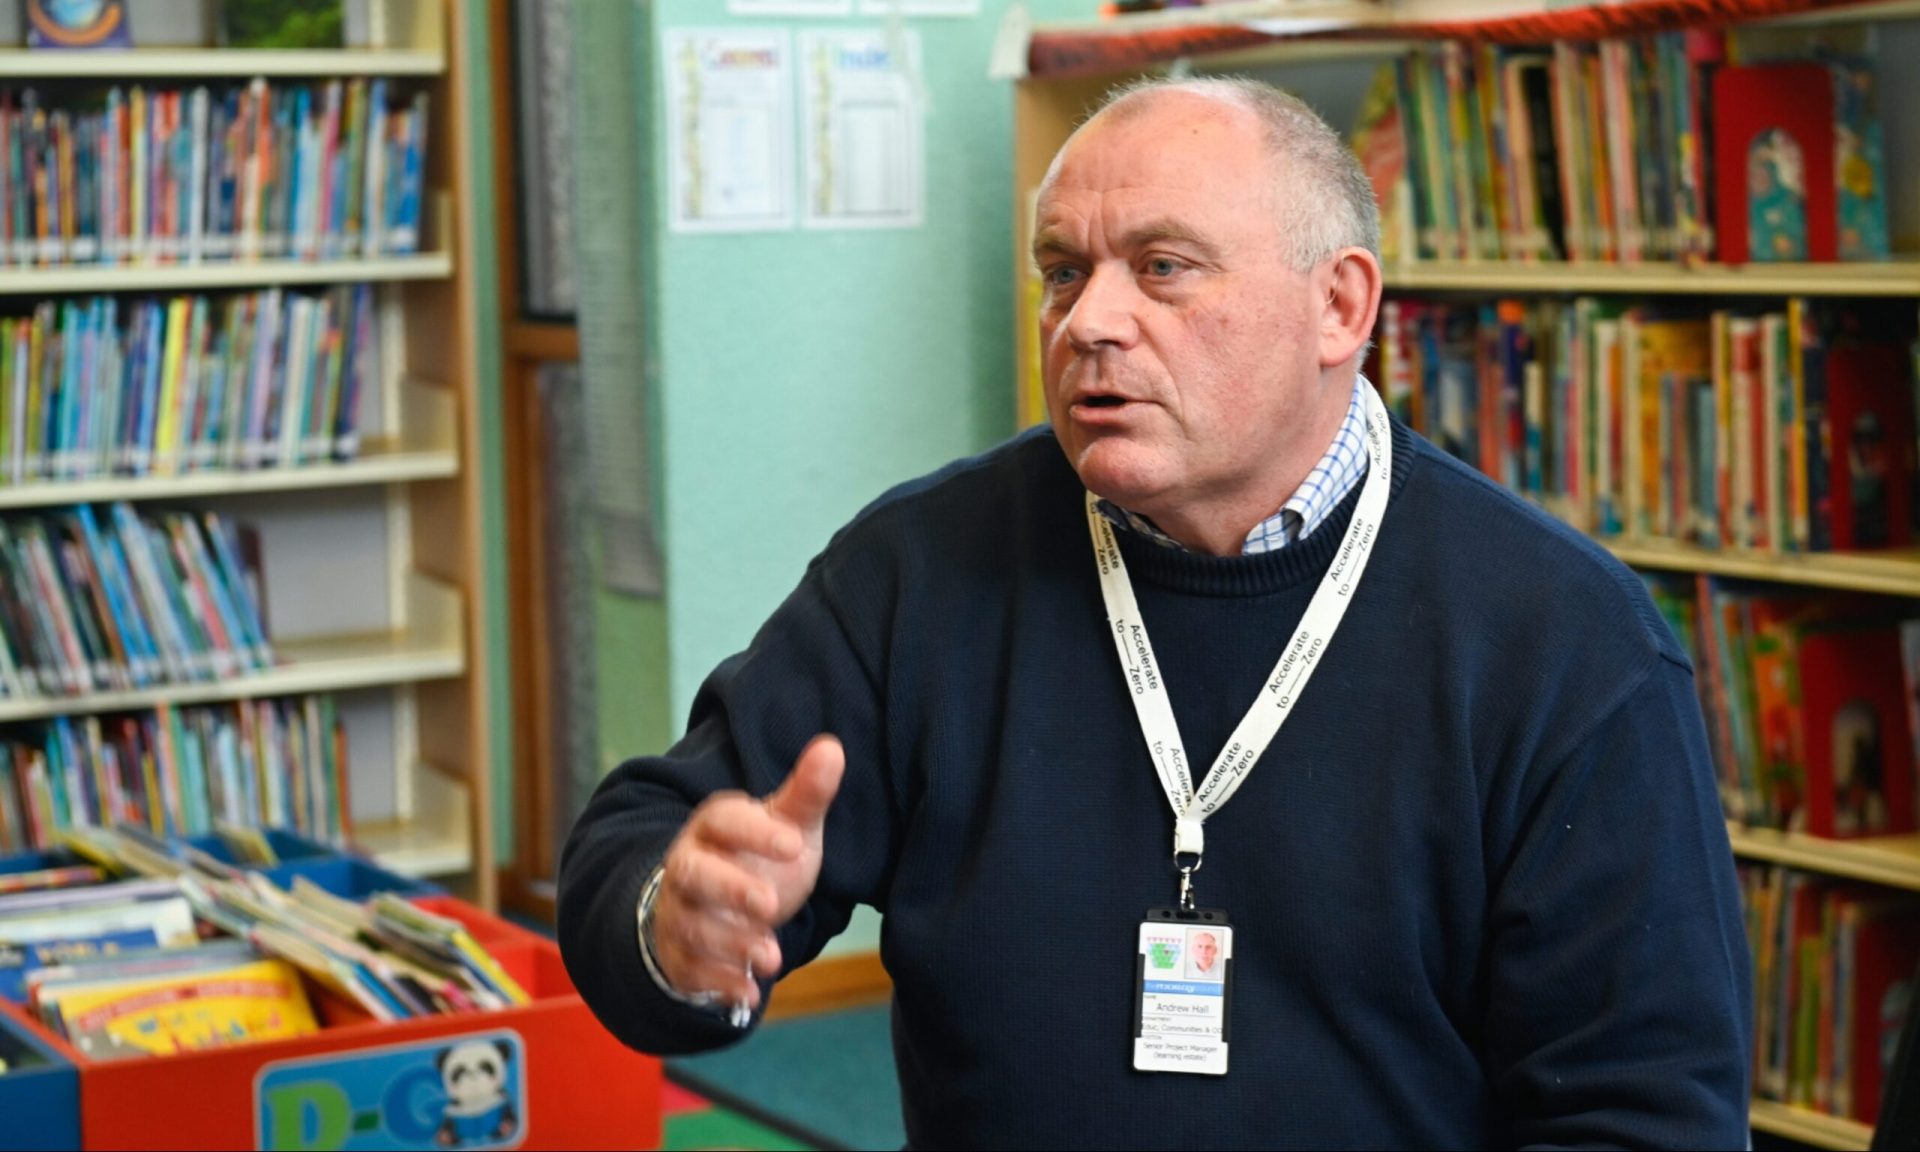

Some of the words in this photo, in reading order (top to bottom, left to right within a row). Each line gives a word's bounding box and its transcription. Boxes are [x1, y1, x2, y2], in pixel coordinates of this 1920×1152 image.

[1098, 546, 1109, 575] Zero
[1330, 518, 1363, 582] Accelerate
[1337, 583, 1350, 596] to
[1358, 523, 1375, 552] Zero
[1115, 619, 1125, 634] to
[1129, 665, 1144, 695] Zero
[1130, 624, 1158, 690] Accelerate
[1269, 631, 1310, 694] Accelerate
[1276, 696, 1290, 709] to
[1301, 638, 1323, 665] Zero
[1153, 740, 1164, 755] to
[1170, 747, 1192, 807] Accelera
[1199, 742, 1241, 803] Accelerate
[1202, 802, 1216, 813] to
[1231, 749, 1255, 777] Zero
[1156, 1003, 1189, 1012] Andrew
[1192, 1005, 1210, 1014] Hall
